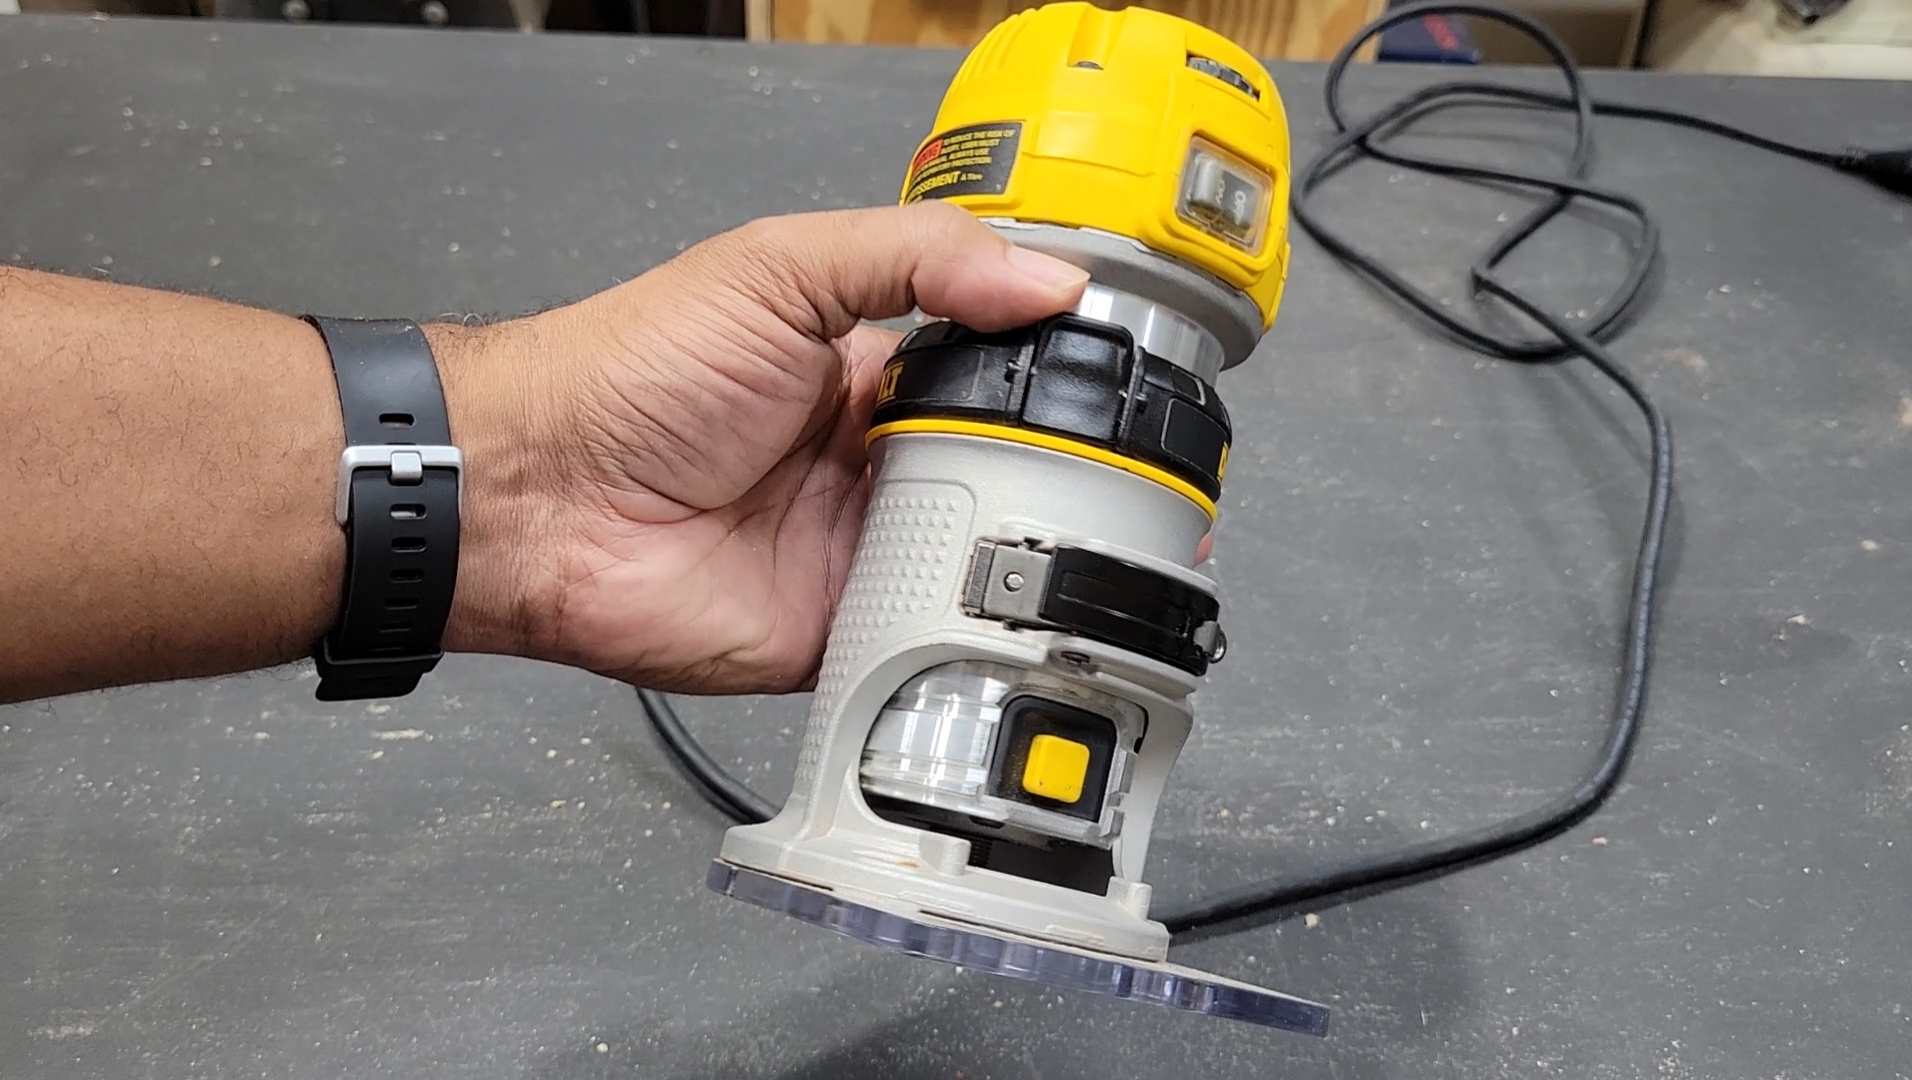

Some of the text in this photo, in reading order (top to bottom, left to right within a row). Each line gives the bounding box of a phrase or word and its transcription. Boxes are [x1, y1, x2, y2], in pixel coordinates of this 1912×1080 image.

[973, 131, 986, 139] THE
[986, 130, 1003, 138] RISK
[1003, 130, 1016, 138] OF
[978, 139, 1000, 147] MUST
[974, 147, 990, 156] USE
